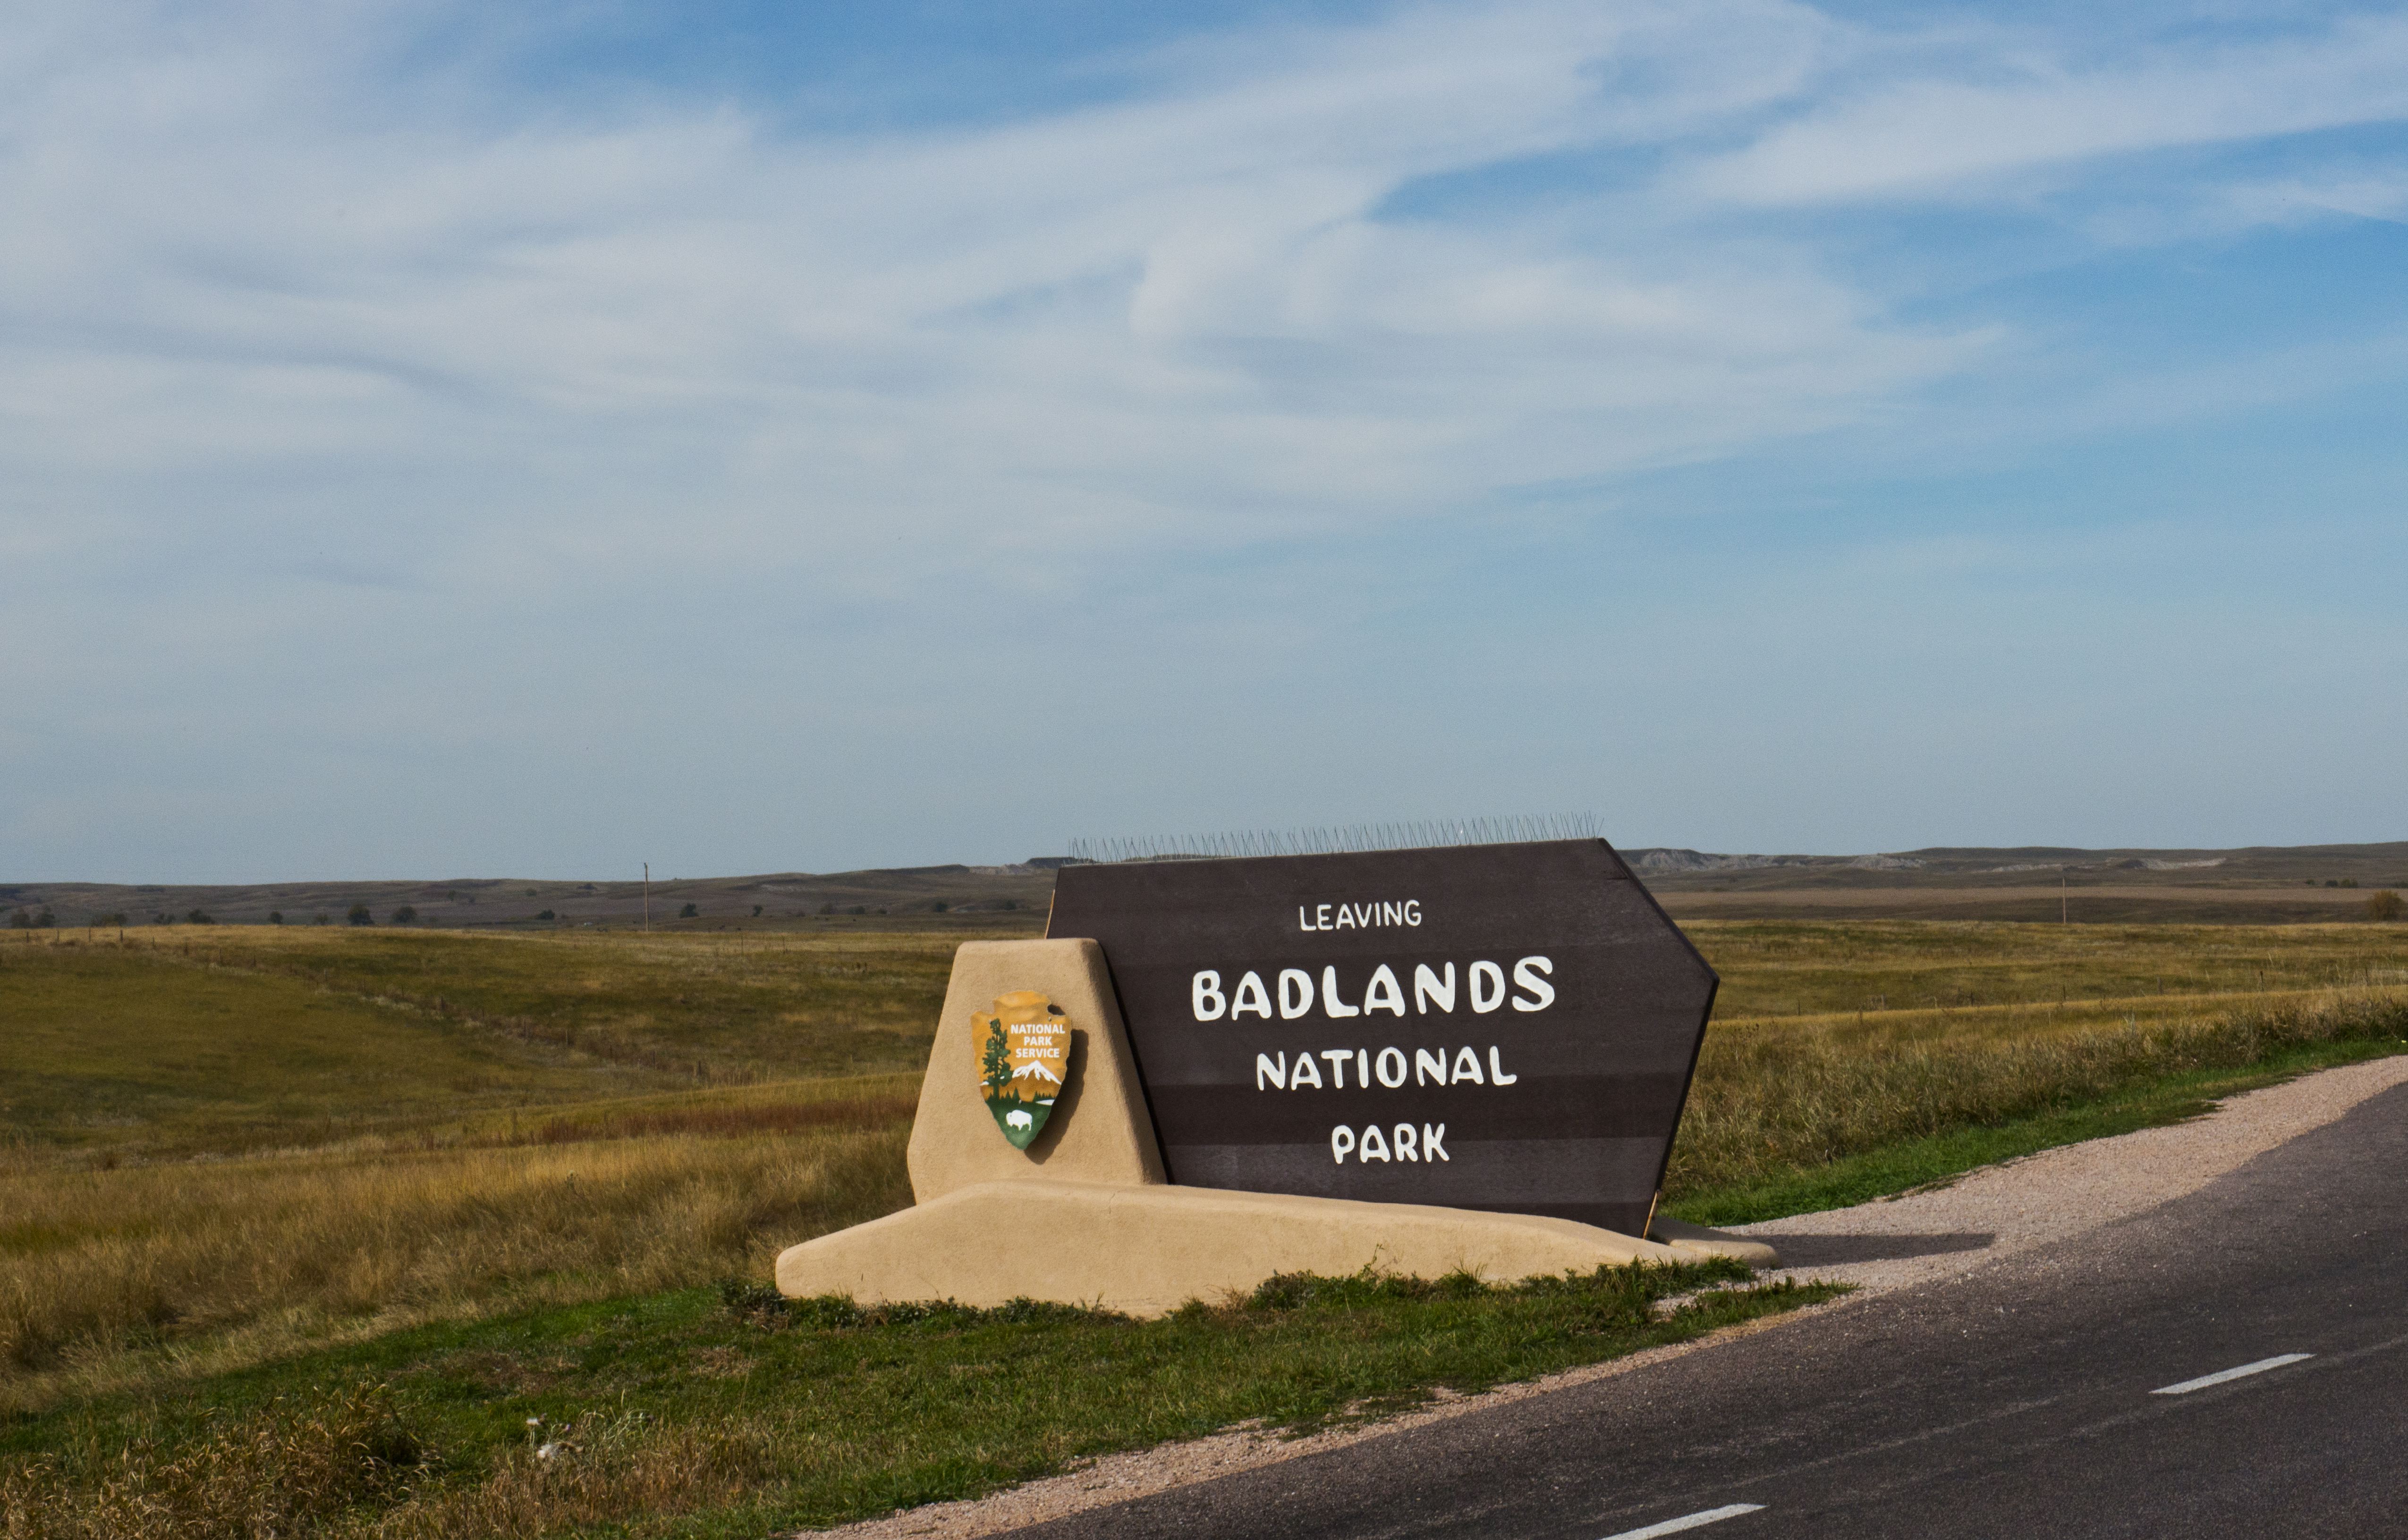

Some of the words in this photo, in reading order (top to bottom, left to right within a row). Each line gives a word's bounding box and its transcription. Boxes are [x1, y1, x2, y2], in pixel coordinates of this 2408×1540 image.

[1299, 899, 1422, 931] LEAVING
[1192, 956, 1555, 1021] BADLANDS
[1010, 1024, 1066, 1034] NATIONAL
[1024, 1035, 1052, 1046] PARK
[1016, 1047, 1060, 1058] SERVICE
[1257, 1046, 1517, 1091] NATIONAL
[1331, 1123, 1450, 1164] PARK
